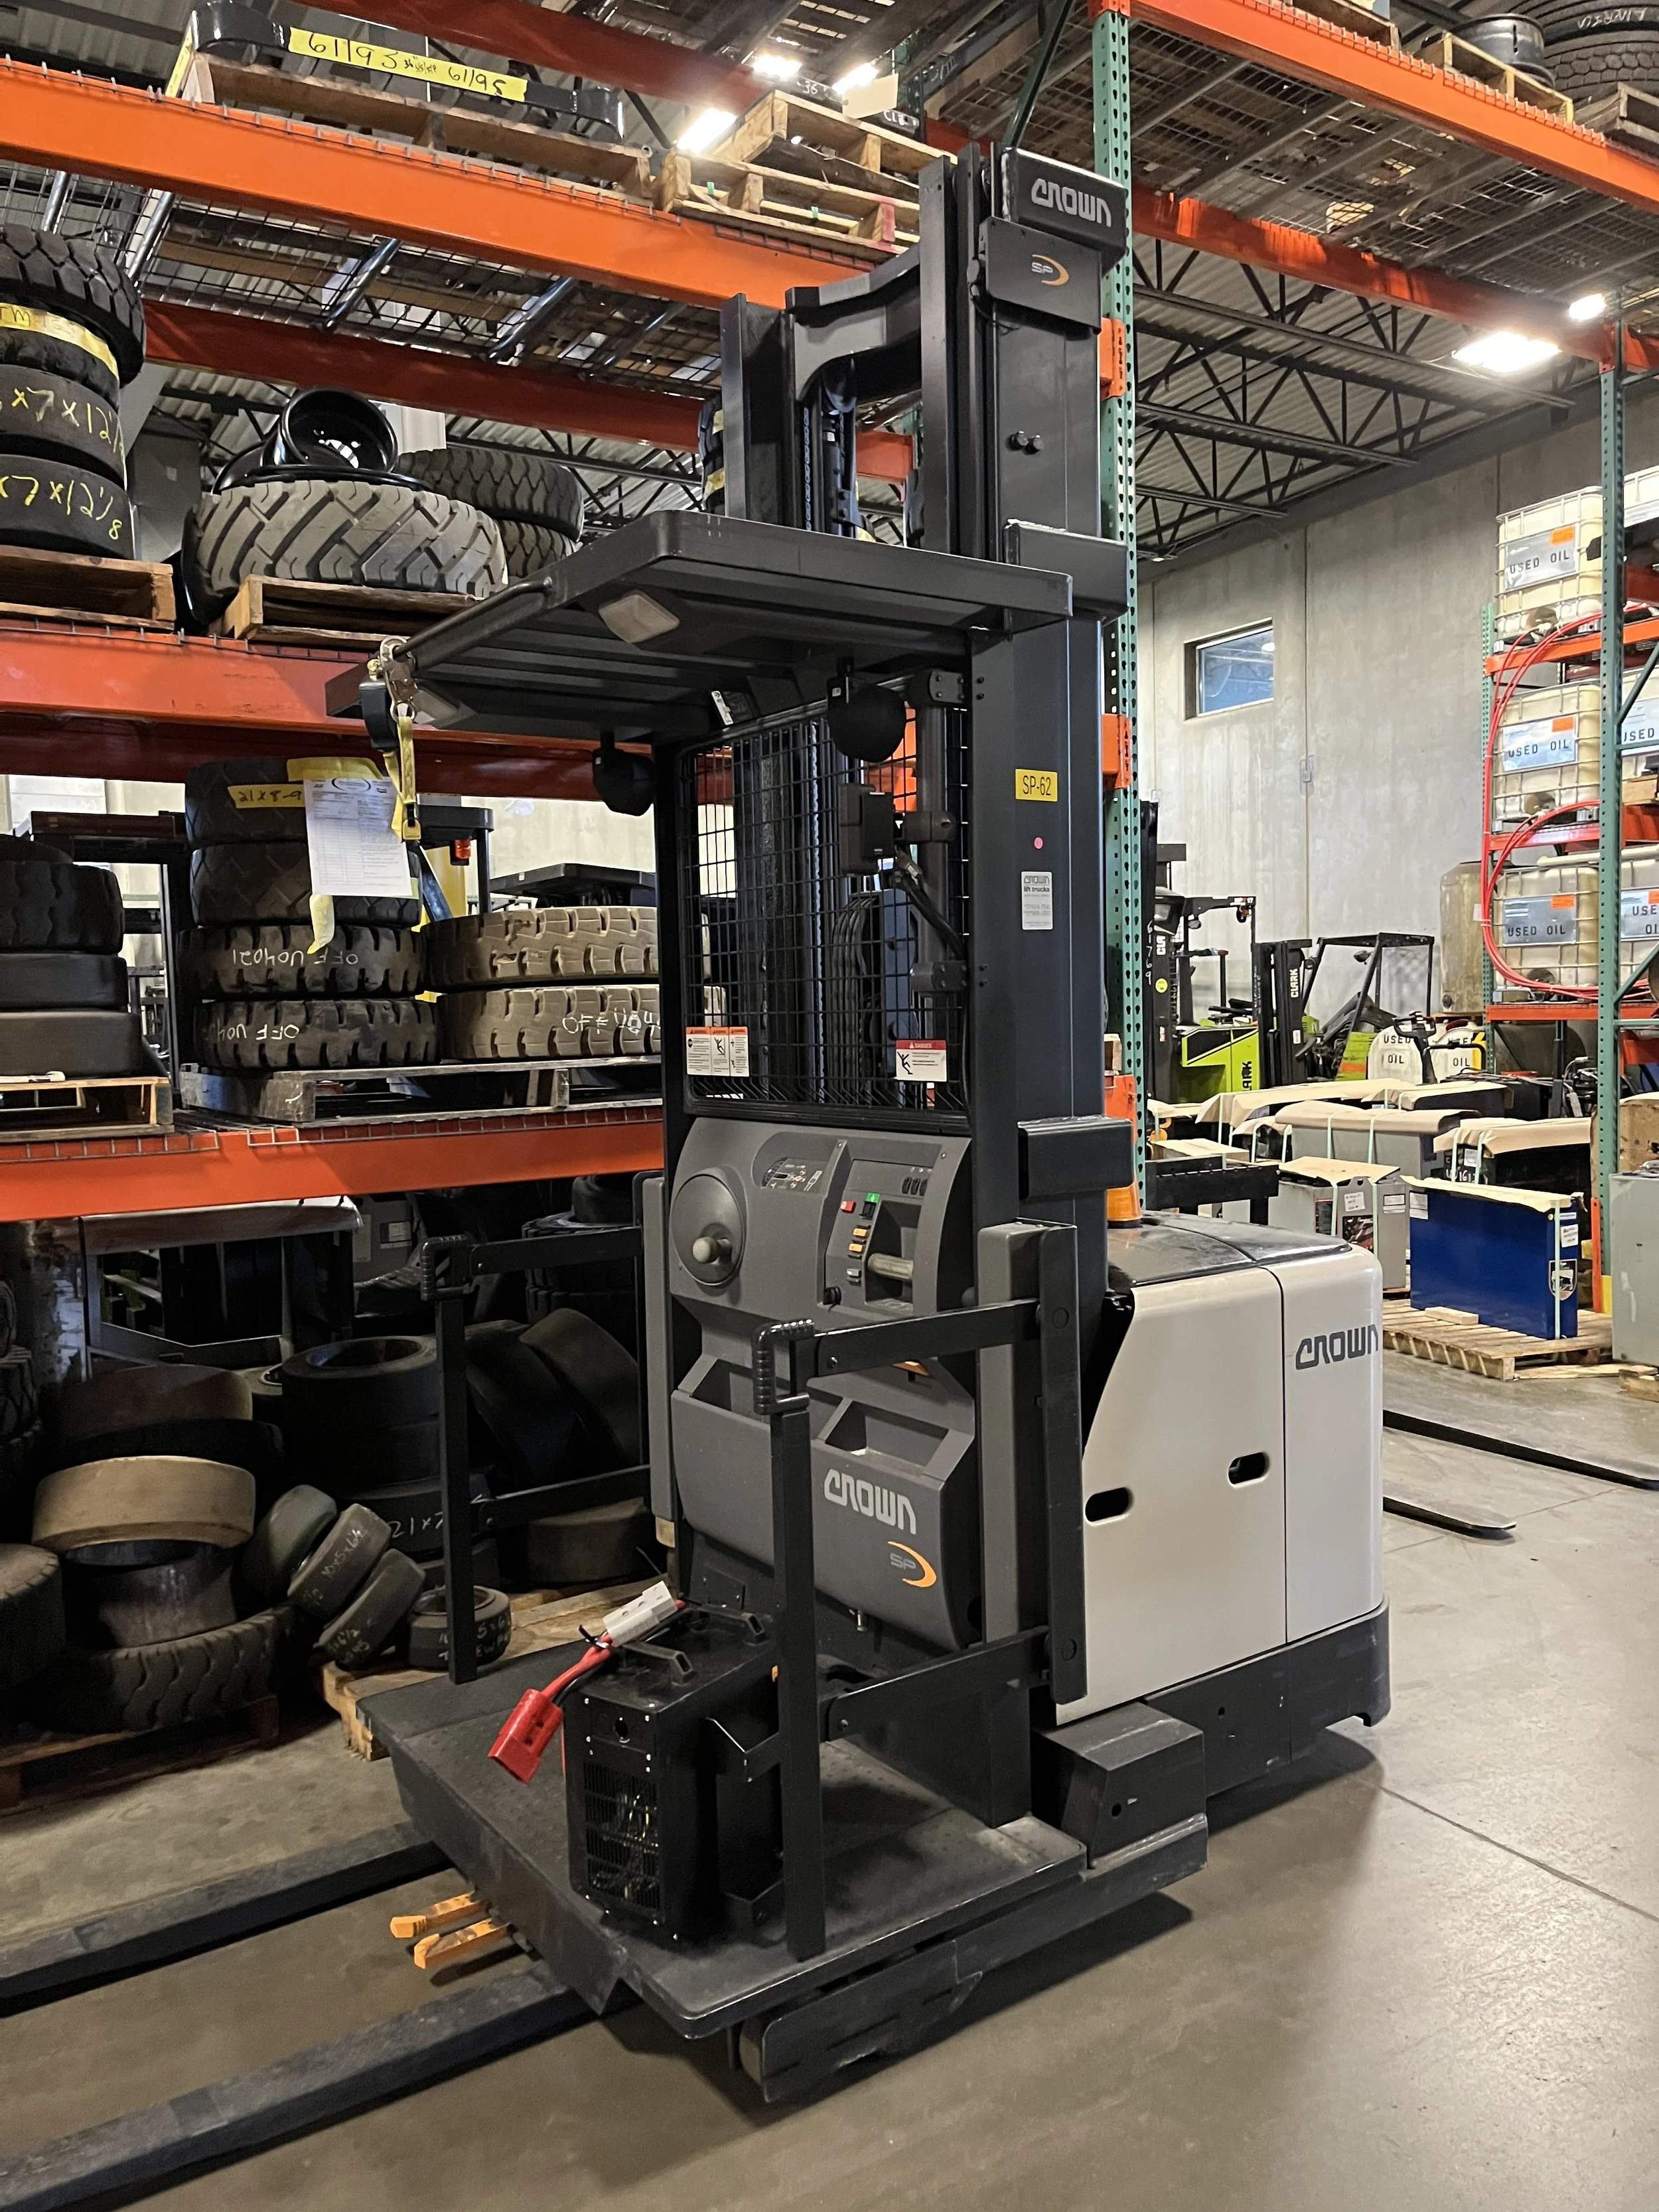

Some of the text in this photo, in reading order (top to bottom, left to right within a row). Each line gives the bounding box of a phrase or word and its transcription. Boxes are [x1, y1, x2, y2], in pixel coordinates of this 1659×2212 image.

[1031, 179, 1112, 228] CROWN
[1032, 262, 1053, 274] SP
[1510, 550, 1569, 574] USED OIL
[1508, 739, 1569, 758] USED OIL
[1023, 775, 1051, 796] SP-62
[1508, 924, 1565, 937] USED OIL
[1289, 968, 1299, 998] CLARK
[1384, 1035, 1411, 1045] USED
[1388, 1055, 1404, 1064] OIL
[1453, 1058, 1471, 1067] OIL
[1295, 1324, 1379, 1370] CROWN
[824, 1469, 916, 1534] CROWN
[890, 1552, 916, 1570] SP
